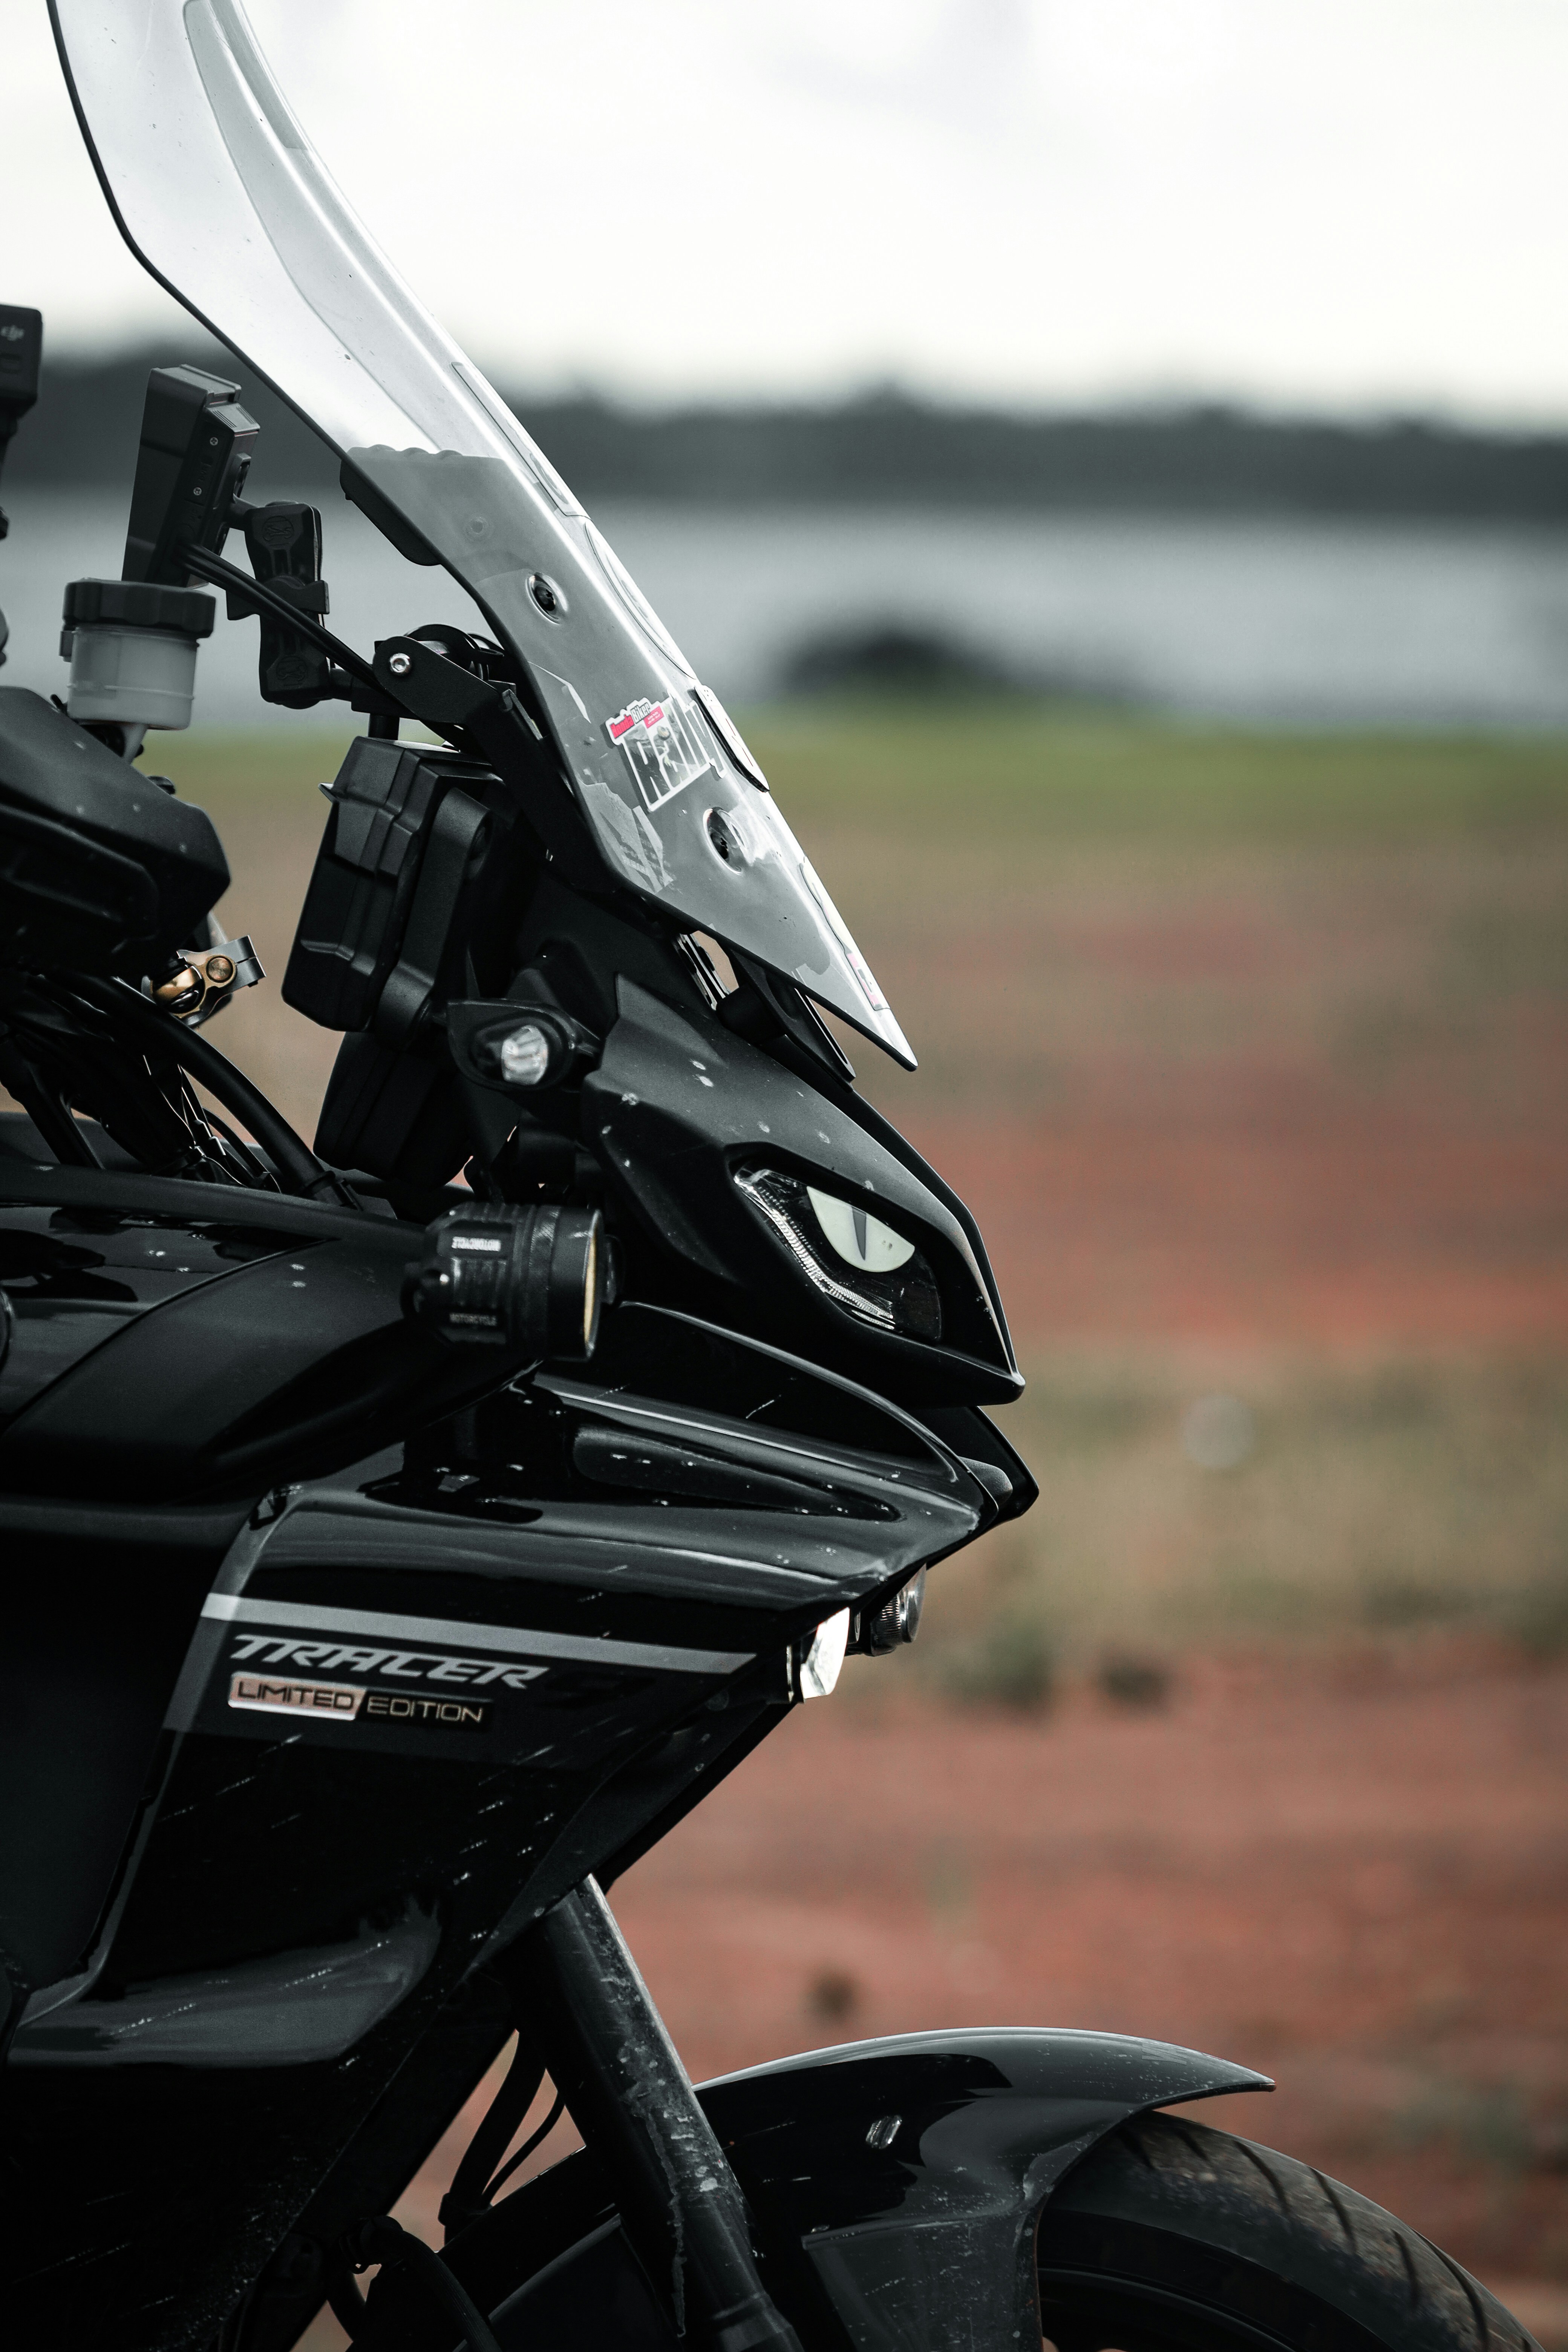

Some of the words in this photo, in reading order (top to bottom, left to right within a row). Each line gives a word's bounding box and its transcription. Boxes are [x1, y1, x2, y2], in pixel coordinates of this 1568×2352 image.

[630, 701, 651, 724] Biker
[622, 697, 725, 805] Rally
[230, 1634, 550, 1689] TRACER
[237, 1680, 355, 1710] LIMITED
[366, 1695, 484, 1723] EDITION
